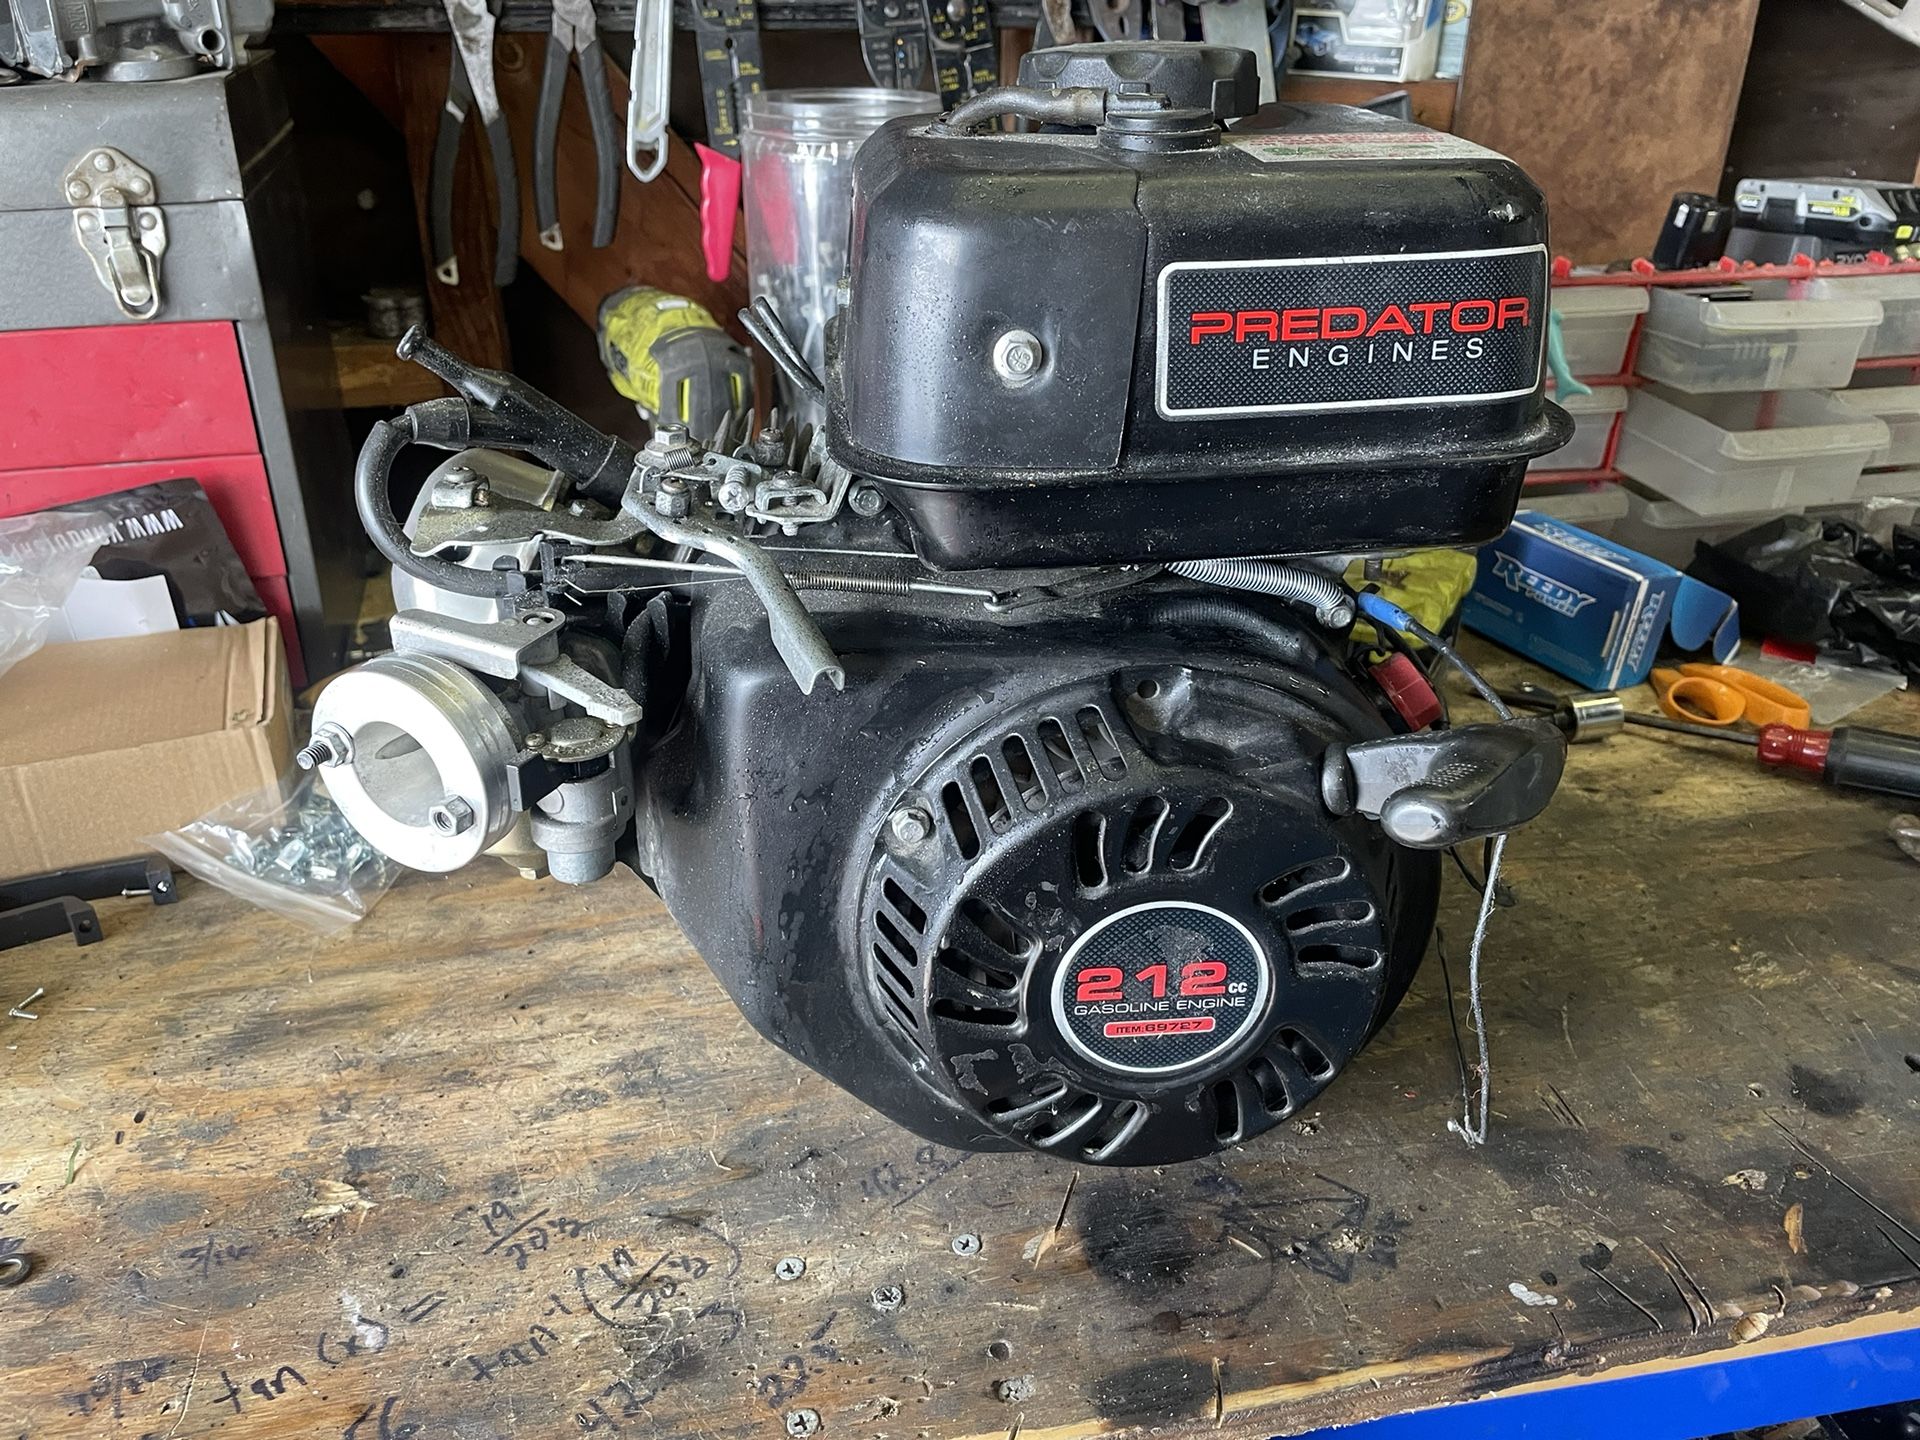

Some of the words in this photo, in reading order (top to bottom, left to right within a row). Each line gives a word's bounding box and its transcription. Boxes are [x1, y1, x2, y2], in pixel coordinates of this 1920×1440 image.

[1190, 297, 1530, 345] PREDATOR
[1252, 337, 1484, 370] ENGINES
[1076, 960, 1228, 1003] 212
[1074, 1001, 1170, 1016] GASOLINE
[1176, 996, 1247, 1011] ENGINE
